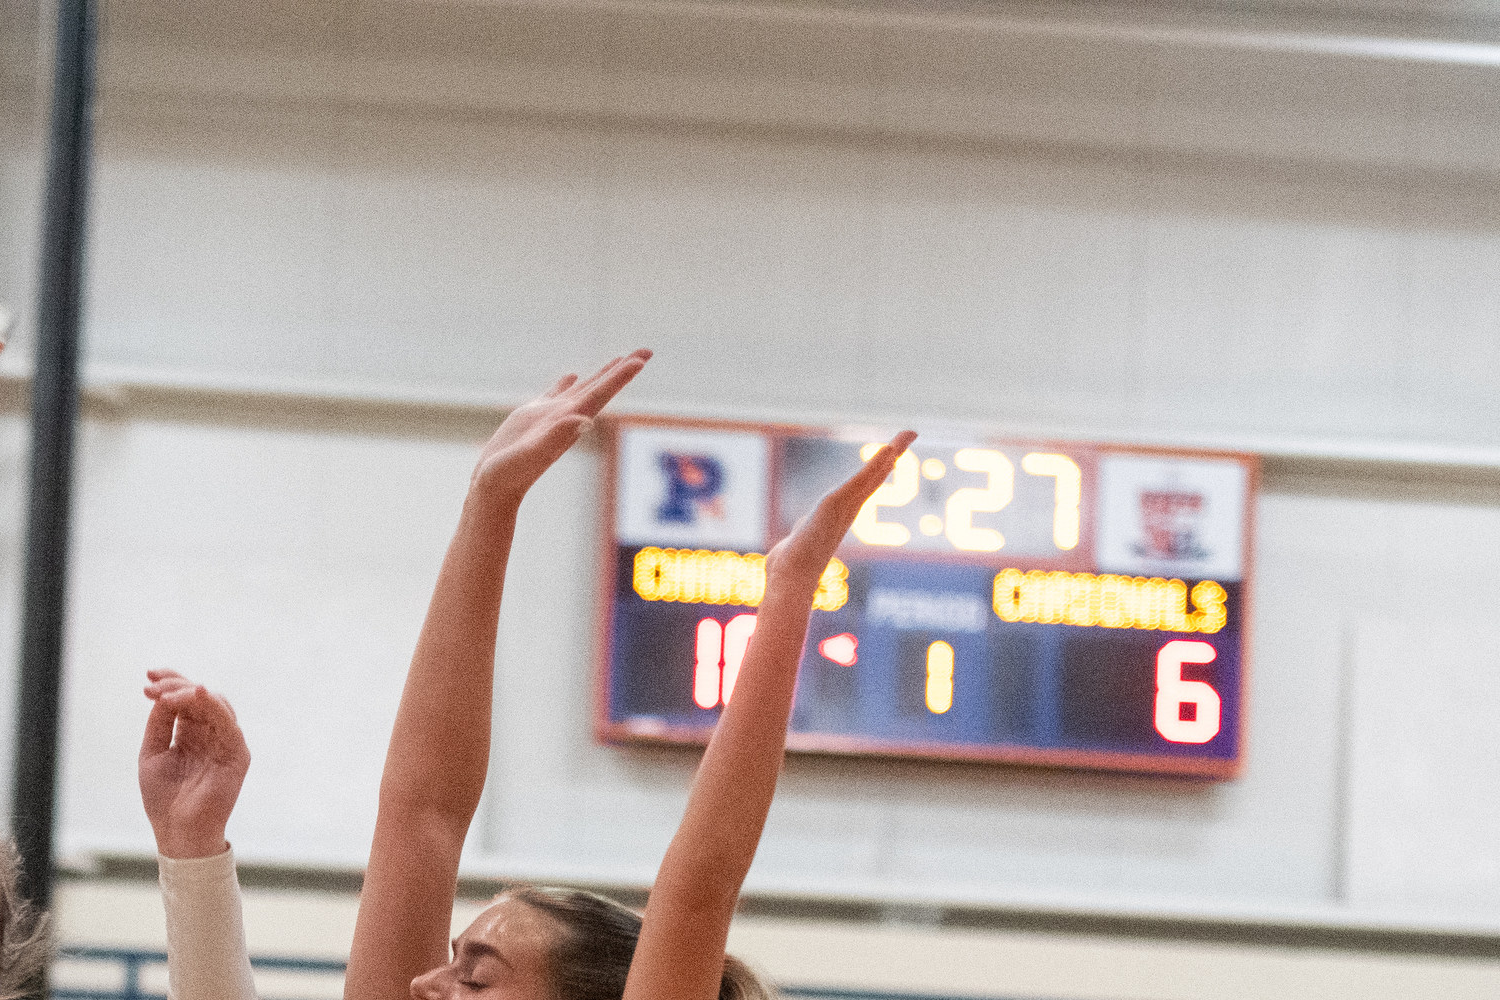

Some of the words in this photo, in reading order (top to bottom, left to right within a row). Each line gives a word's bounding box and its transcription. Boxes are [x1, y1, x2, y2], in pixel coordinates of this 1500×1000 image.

[852, 442, 1082, 552] 2:27
[925, 641, 955, 714] 1
[1154, 639, 1222, 744] 6
